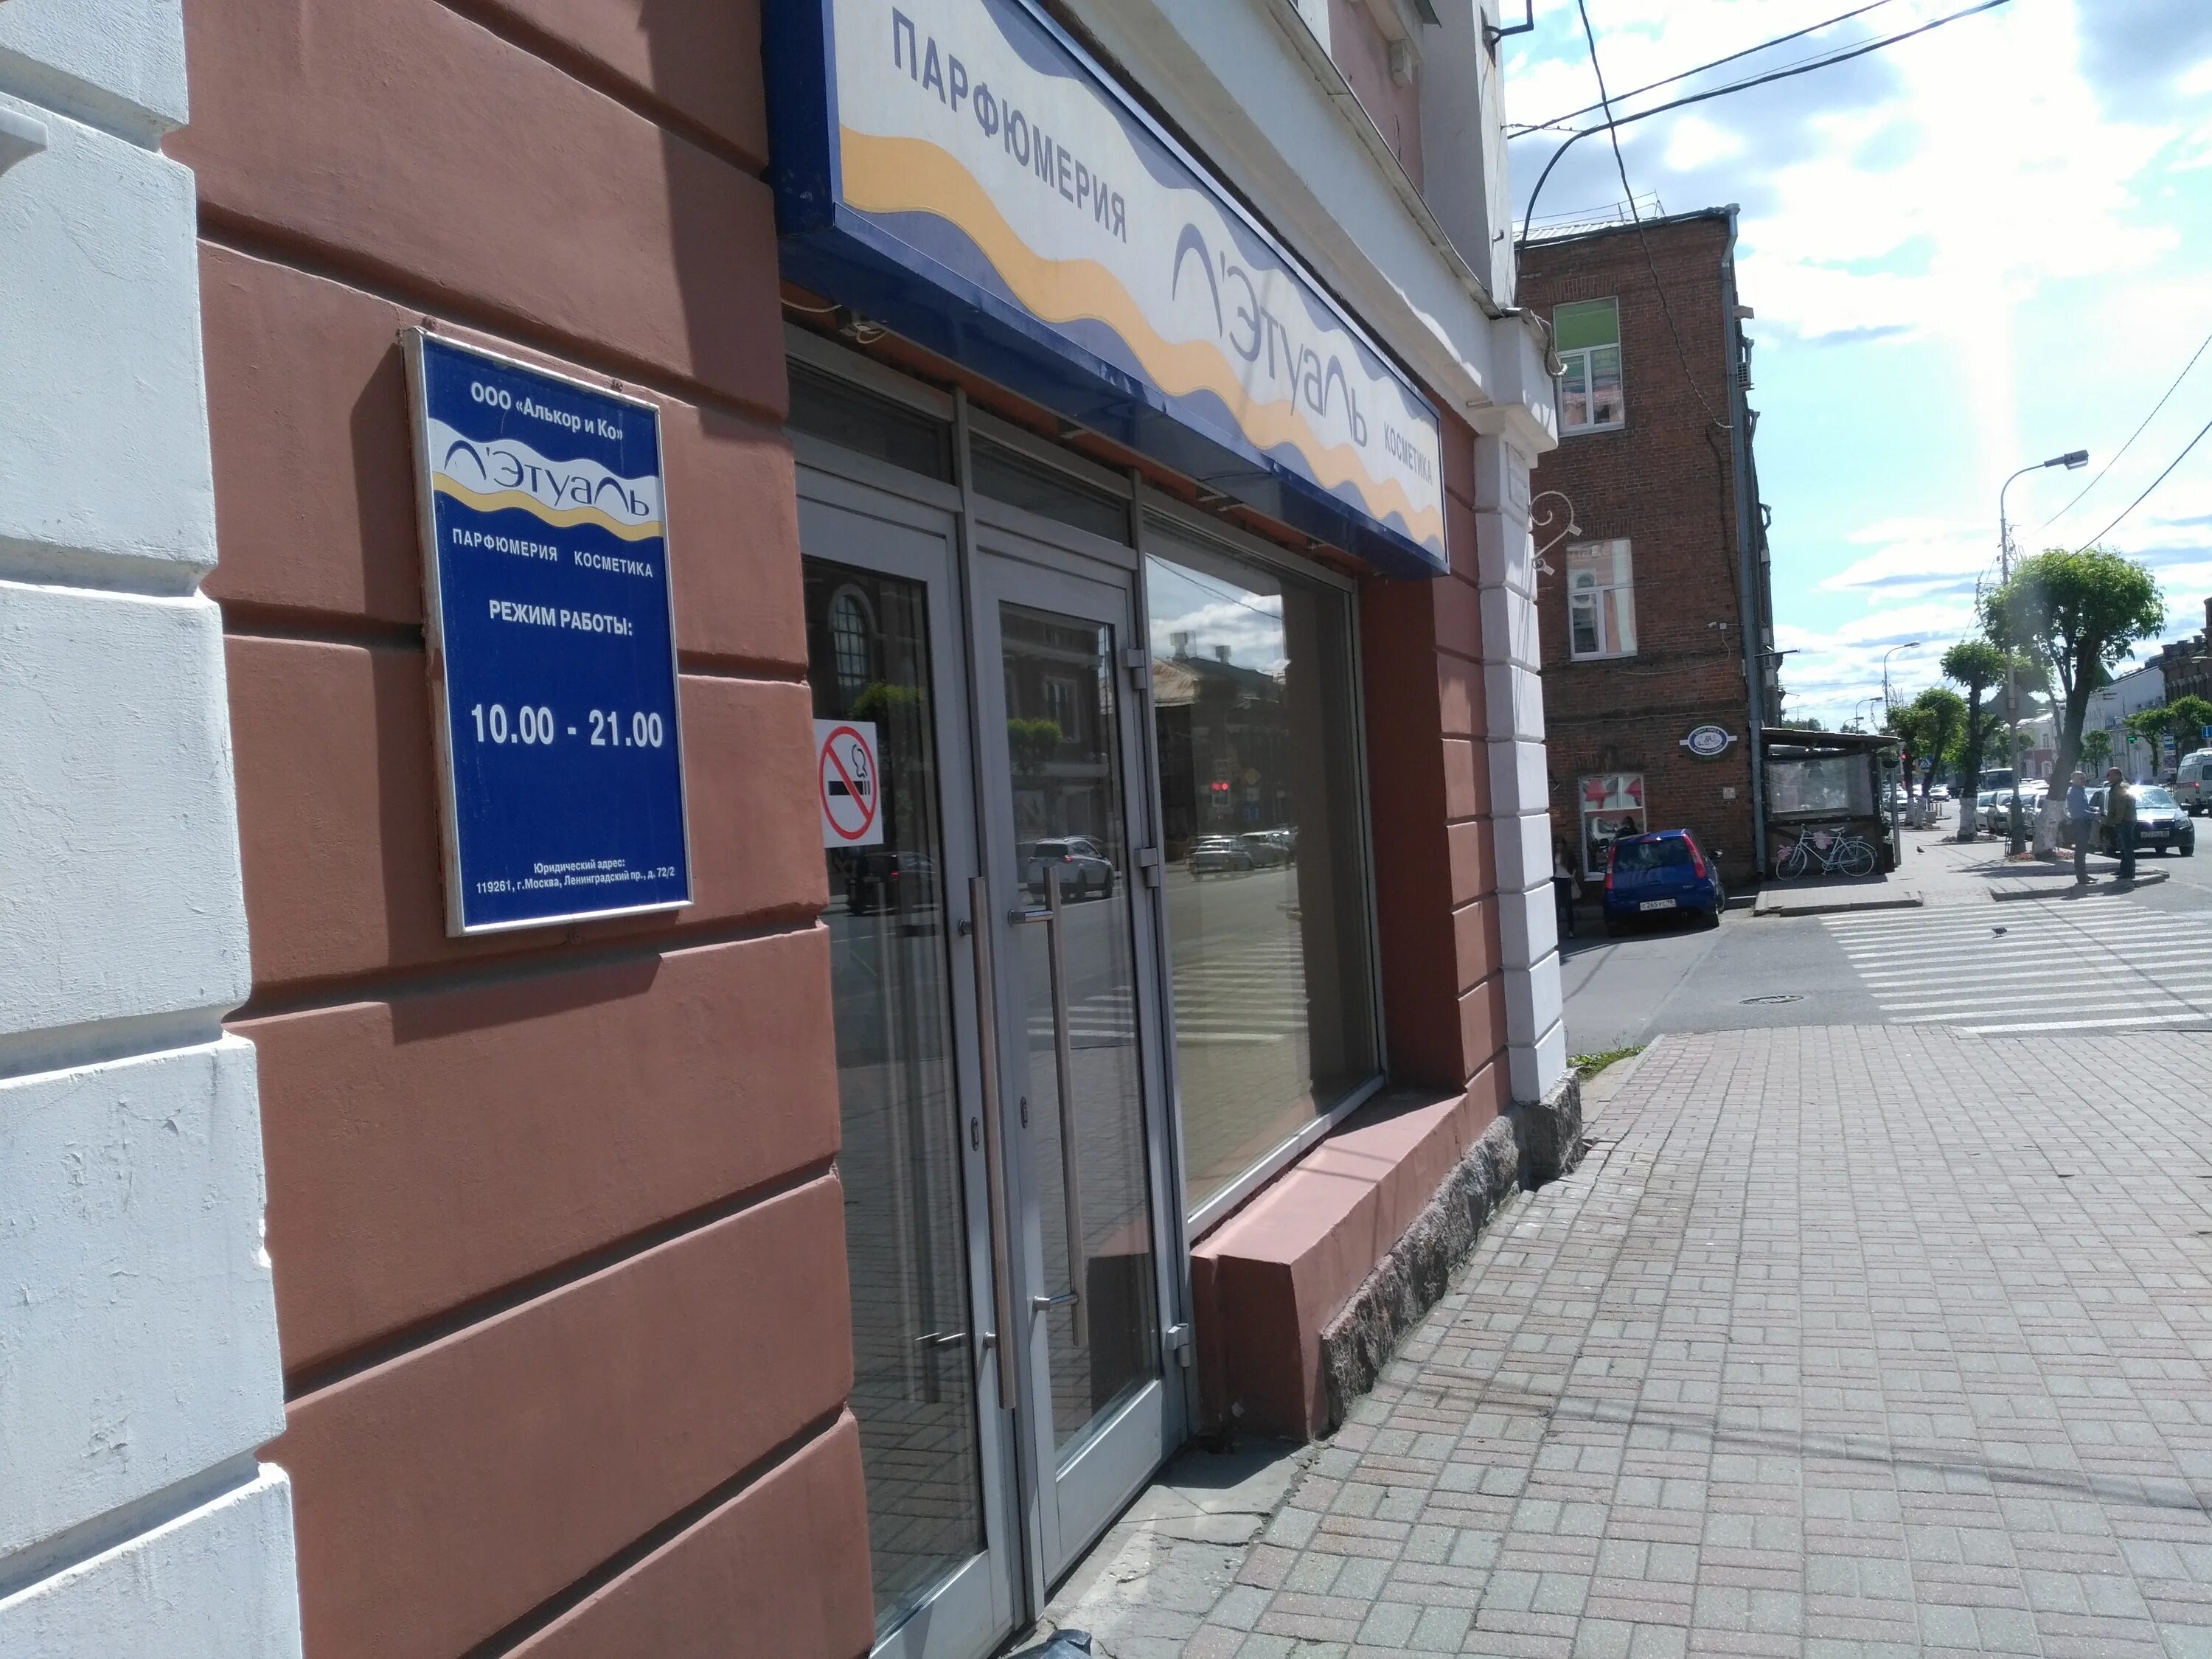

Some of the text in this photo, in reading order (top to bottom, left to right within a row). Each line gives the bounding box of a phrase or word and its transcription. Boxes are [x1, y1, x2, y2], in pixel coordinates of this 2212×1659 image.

[892, 6, 1127, 244] ПАРФЮМЕРИЯ
[1383, 421, 1433, 485] КОСМЕТИКА
[470, 381, 624, 441] ООО «Алькор и Ко»
[452, 528, 653, 578] ПАРФЮМЕРИЯ КОСМЕТИКА
[489, 599, 633, 636] РЕЖИМ РАБОТЫ:
[471, 703, 554, 745] 10.00
[589, 709, 663, 748] 21.00
[476, 880, 515, 894] 119261,
[564, 870, 629, 886] Ленинградский
[630, 872, 646, 882] пр.,
[647, 872, 655, 880] д.
[657, 866, 675, 879] 72/2
[534, 858, 625, 876] Юридический адрес:
